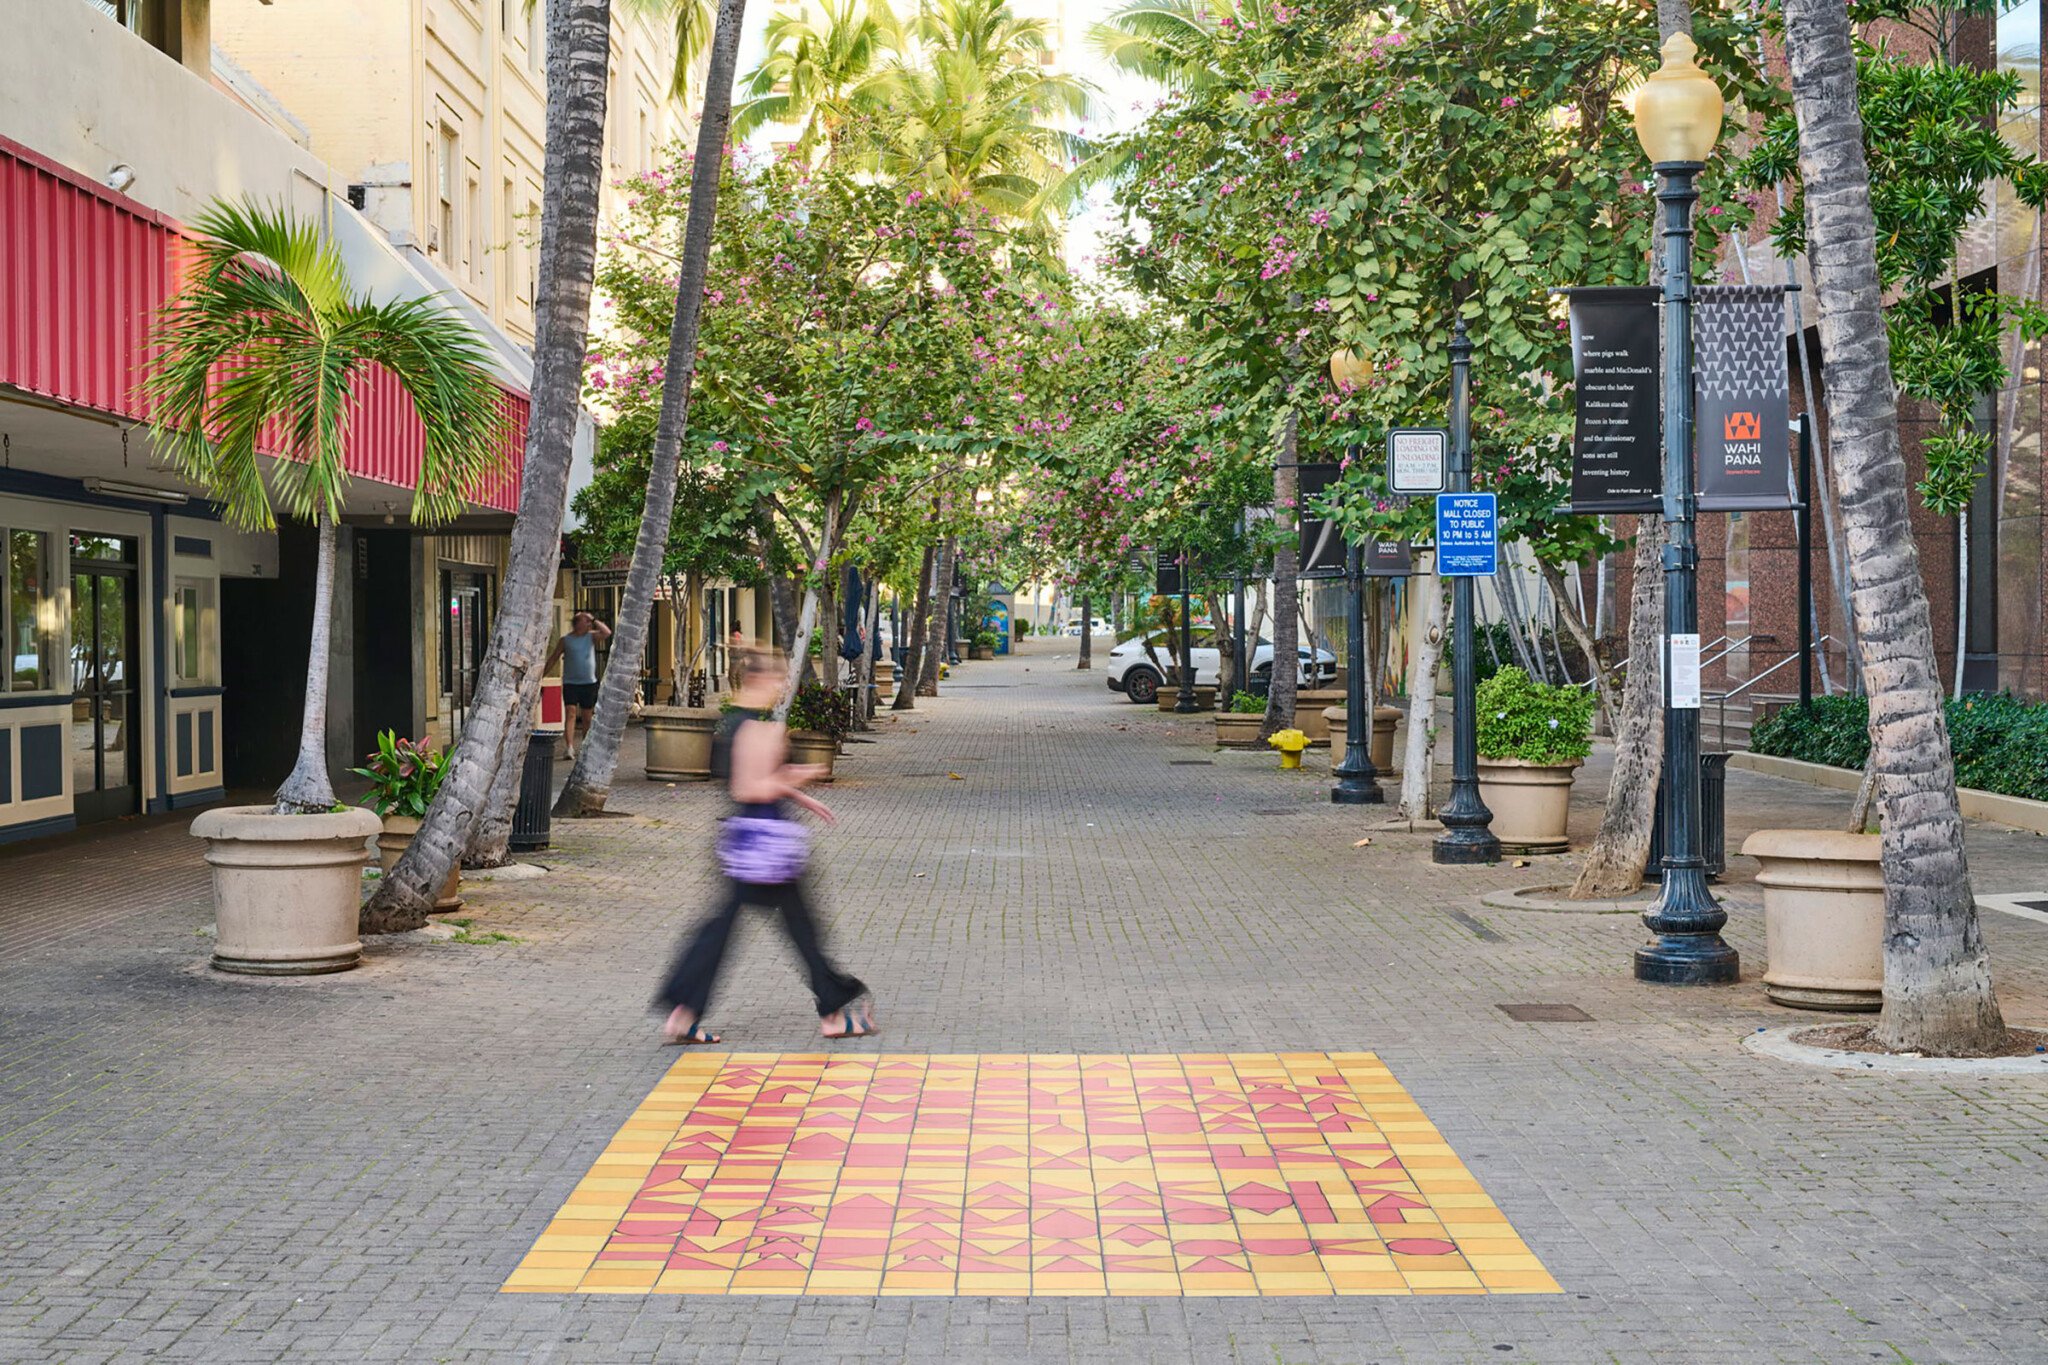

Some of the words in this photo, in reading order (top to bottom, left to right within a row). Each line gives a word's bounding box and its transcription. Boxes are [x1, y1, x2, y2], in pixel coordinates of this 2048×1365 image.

[1602, 350, 1614, 358] pigs
[1604, 435, 1636, 443] missionary
[1724, 443, 1761, 454] WAHI
[1725, 454, 1762, 465] PANA
[1582, 469, 1609, 477] inventing
[1610, 469, 1630, 477] history
[1454, 499, 1478, 507] NOTICE
[1450, 520, 1459, 528] TO
[1461, 520, 1485, 528] PUBLIC
[1443, 530, 1450, 538] 10
[1452, 530, 1462, 538] PM
[1474, 530, 1479, 538] 5
[1481, 530, 1492, 538] AM
